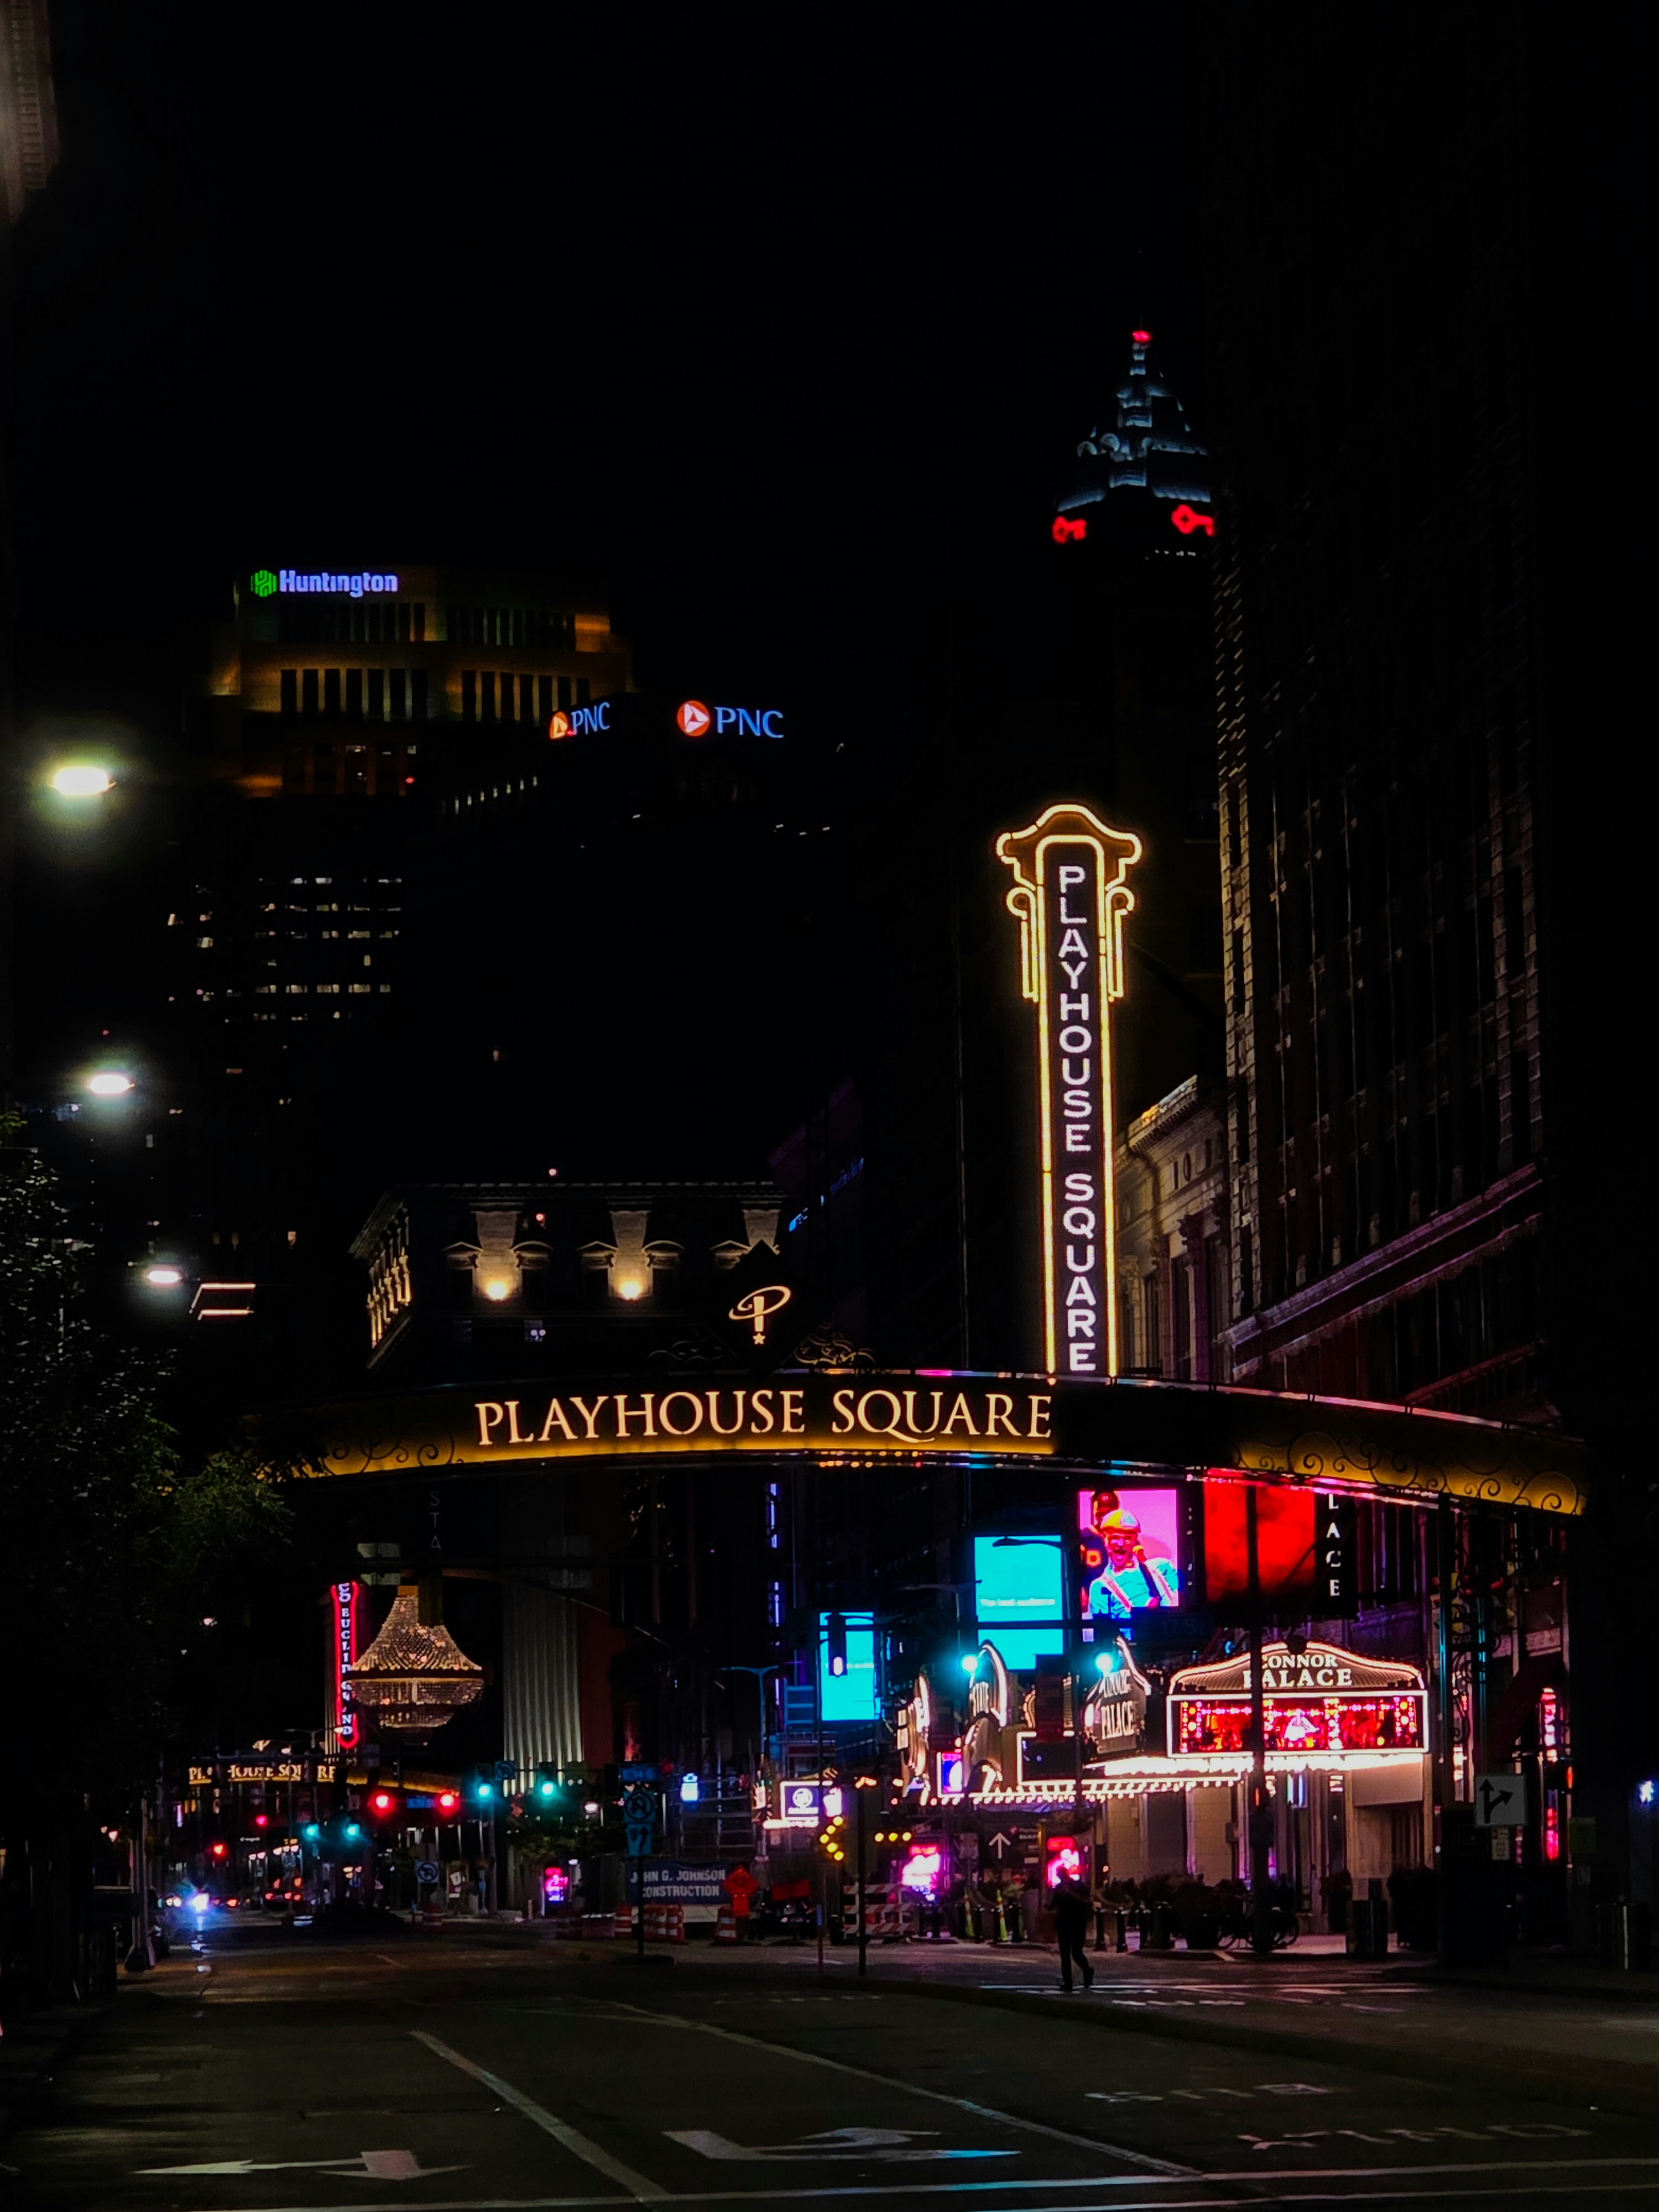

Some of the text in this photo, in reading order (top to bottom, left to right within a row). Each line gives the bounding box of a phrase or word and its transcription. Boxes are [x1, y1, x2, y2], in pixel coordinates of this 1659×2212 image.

[279, 570, 398, 598] Huntington
[571, 702, 609, 737] PNC
[714, 707, 784, 738] PNC
[1058, 865, 1097, 1372] PLAYHOUSE SQUARE
[474, 1389, 1053, 1446] PLAYHOUSE SQUARE
[1100, 1700, 1135, 1740] PALACE
[630, 1869, 726, 1884] JHN G. JOHNSON
